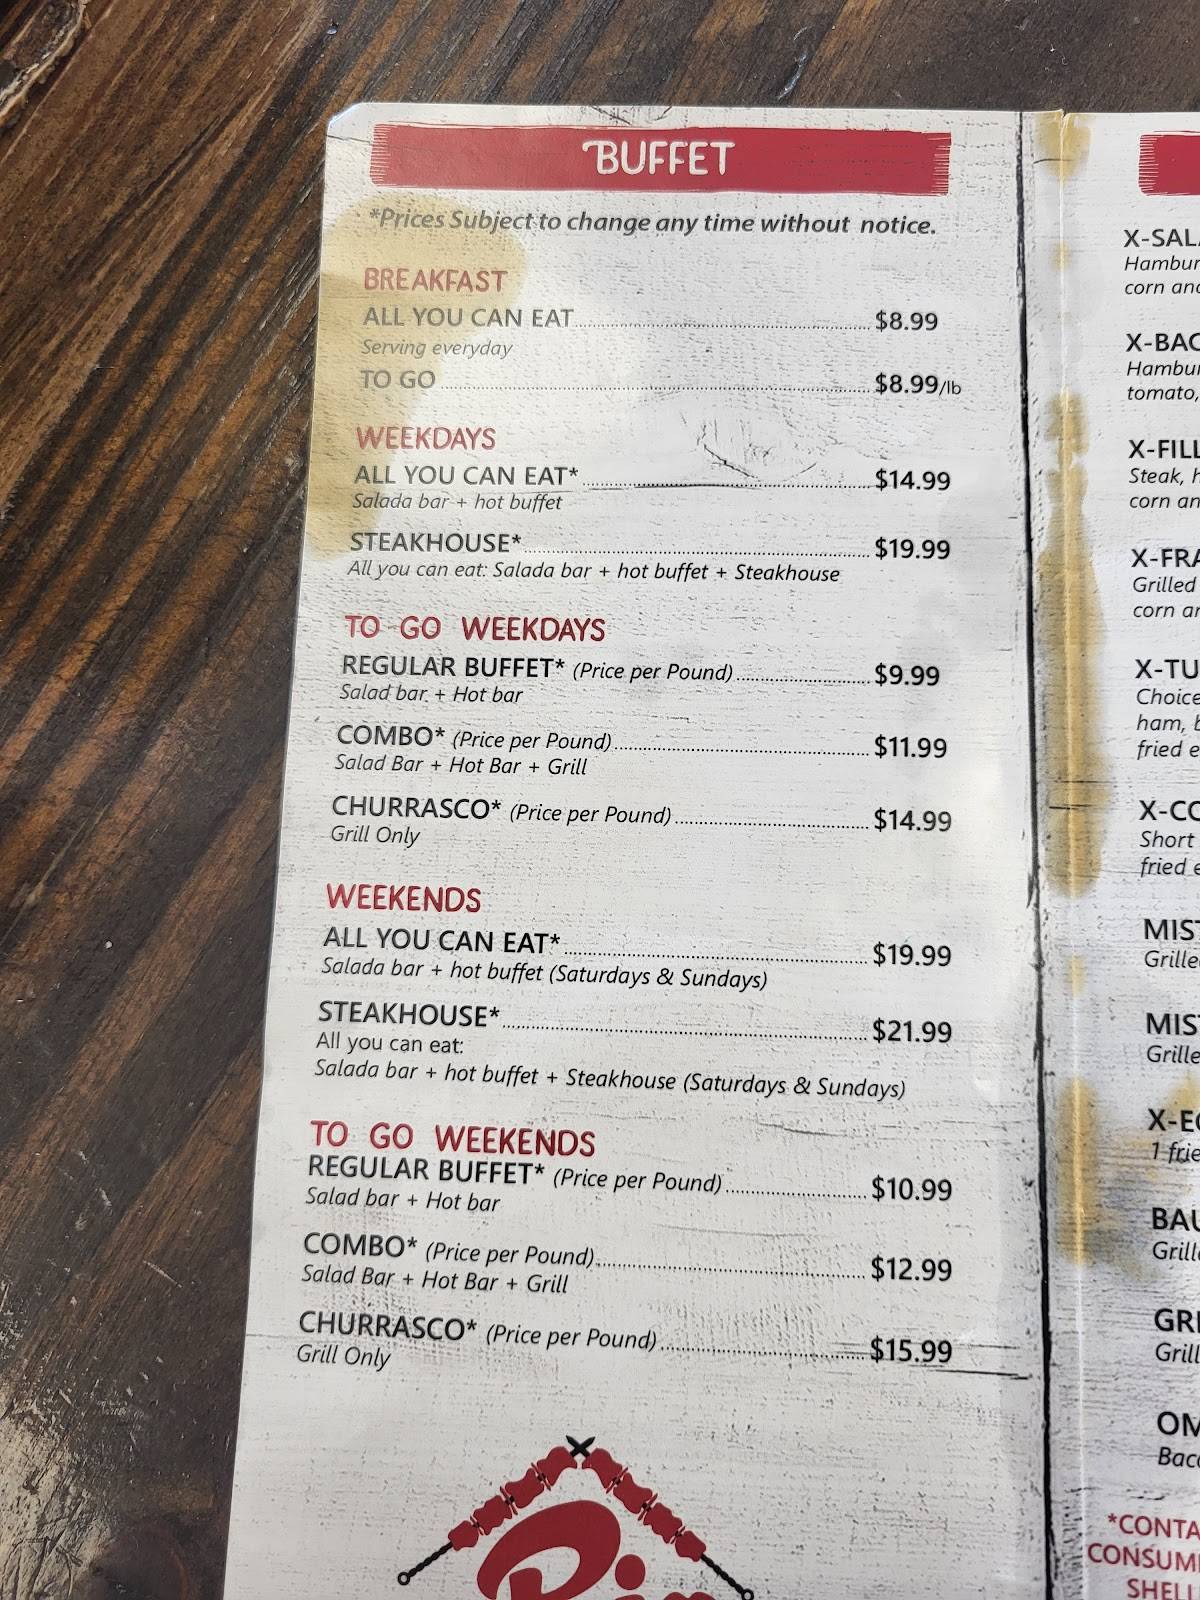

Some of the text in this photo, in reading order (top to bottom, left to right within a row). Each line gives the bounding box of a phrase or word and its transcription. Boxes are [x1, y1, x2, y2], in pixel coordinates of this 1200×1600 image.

[582, 140, 735, 175] BUFFET
[451, 210, 533, 234] Subject
[539, 213, 561, 230] to
[567, 212, 650, 236] change
[655, 216, 698, 236] any
[704, 214, 754, 232] time
[761, 214, 851, 233] without
[860, 216, 936, 235] notice.
[364, 267, 508, 293] BREAKFAST
[1124, 282, 1165, 295] corn
[363, 308, 938, 332] ALL YOU CAN EAT $8.99
[361, 339, 513, 359] Serving everyday
[360, 370, 961, 396] TO GO $8.99/lb
[1127, 385, 1199, 403] tomato,
[357, 426, 496, 450] WEEKDAYS
[354, 465, 396, 485] ALL
[404, 465, 455, 485] YOU
[463, 466, 515, 486] CAN
[875, 468, 951, 491] $14.99
[1129, 467, 1184, 486] Steak,
[352, 493, 563, 513] Salada bar hot buffet
[1130, 495, 1170, 509] corn
[875, 537, 951, 560] $19.99
[347, 560, 840, 582] All you can eat: Salada bar hot buffet Steakhouse
[1133, 576, 1196, 593] Grilled
[1133, 605, 1175, 618] corn
[345, 615, 605, 642] TO GO WEEKDAYS
[342, 655, 456, 677] REGULAR
[573, 662, 624, 681] (Price
[630, 665, 663, 683] per
[667, 664, 733, 683] Pound)
[874, 662, 940, 686] $9.99
[340, 684, 523, 703] Salad bar Hot bar
[1136, 714, 1186, 734] ham,
[453, 731, 505, 750] (Price
[509, 735, 541, 752] per
[546, 733, 612, 752] Pound)
[874, 734, 947, 759] $11.99
[1137, 740, 1182, 760] fried
[335, 754, 587, 775] Salad Bar Hot Bar Grill
[510, 803, 562, 823] (Price
[567, 808, 599, 826] per
[605, 806, 671, 827] Pound)
[874, 807, 951, 832] $14.99
[331, 824, 420, 848] Grill Only
[1140, 830, 1195, 848] Short
[1141, 857, 1187, 878] fried
[326, 883, 481, 912] WEEKENDS
[323, 927, 368, 948] ALL
[377, 928, 430, 949] YOU
[439, 930, 493, 952] CAN
[873, 941, 952, 967] $19.99
[322, 957, 767, 992] Salada bar hot buffet (Saturdays & Sundays)
[872, 1017, 952, 1043] $21.99
[316, 1031, 463, 1054] All you can eat:
[315, 1059, 906, 1101] Salada bar hot buffet Steakhouse (Saturdays & Sundays)
[311, 1120, 596, 1157] TO GO WEEKENDS
[1151, 1142, 1160, 1160] 1
[308, 1154, 429, 1180] REGULAR
[553, 1168, 608, 1188] (Price
[613, 1173, 647, 1192] per
[652, 1172, 722, 1193] Pound)
[871, 1174, 953, 1202] $10.99
[305, 1187, 501, 1212] Salad bar Hot bar
[426, 1241, 481, 1262] (Price
[486, 1248, 519, 1267] per
[524, 1246, 594, 1268] Pound)
[870, 1255, 952, 1282] $12.99
[301, 1264, 568, 1293] Salad Bar Hot Bar Grill
[486, 1324, 541, 1345] (Price
[546, 1330, 580, 1350] per
[586, 1327, 657, 1352] Pound)
[870, 1336, 952, 1364] $15.99
[297, 1344, 391, 1372] Grill Only
